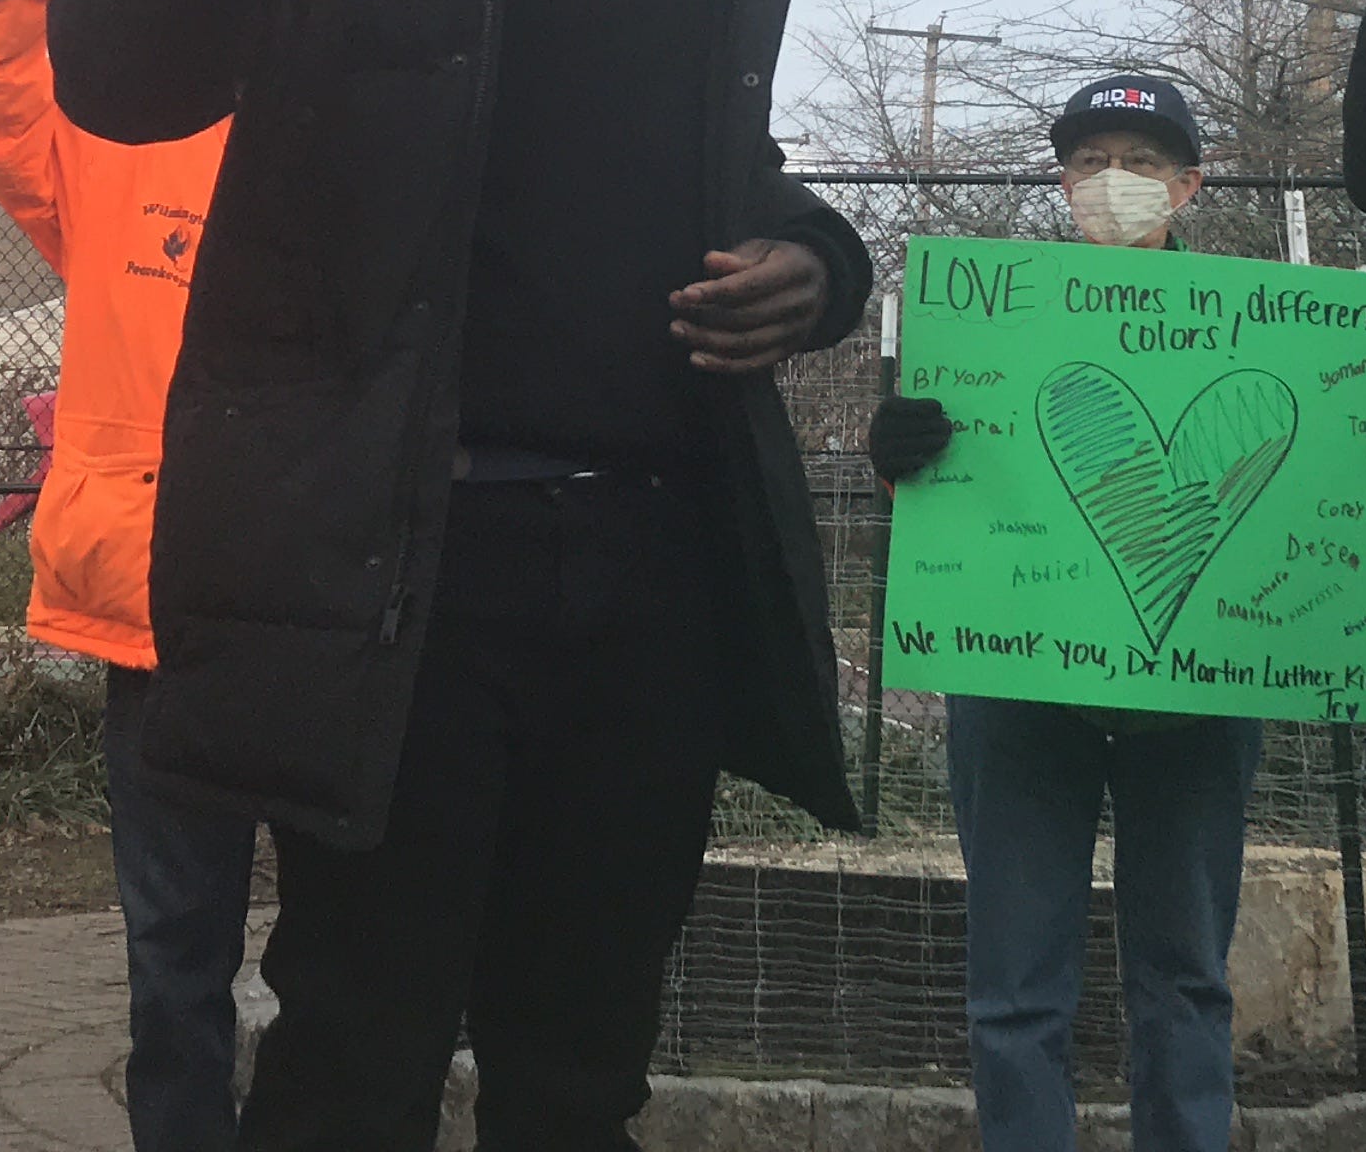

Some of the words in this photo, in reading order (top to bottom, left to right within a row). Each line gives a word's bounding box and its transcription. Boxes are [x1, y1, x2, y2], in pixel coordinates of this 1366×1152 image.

[1091, 88, 1155, 105] BIDEN
[142, 204, 204, 225] Wilmingt
[919, 250, 1036, 317] LOVE
[1189, 281, 1223, 317] in
[940, 410, 1018, 438] arai
[892, 620, 937, 656] We
[951, 625, 1044, 658] thank
[1053, 639, 1117, 681] you,
[1171, 647, 1254, 687] Martin
[1263, 654, 1335, 689] Luther
